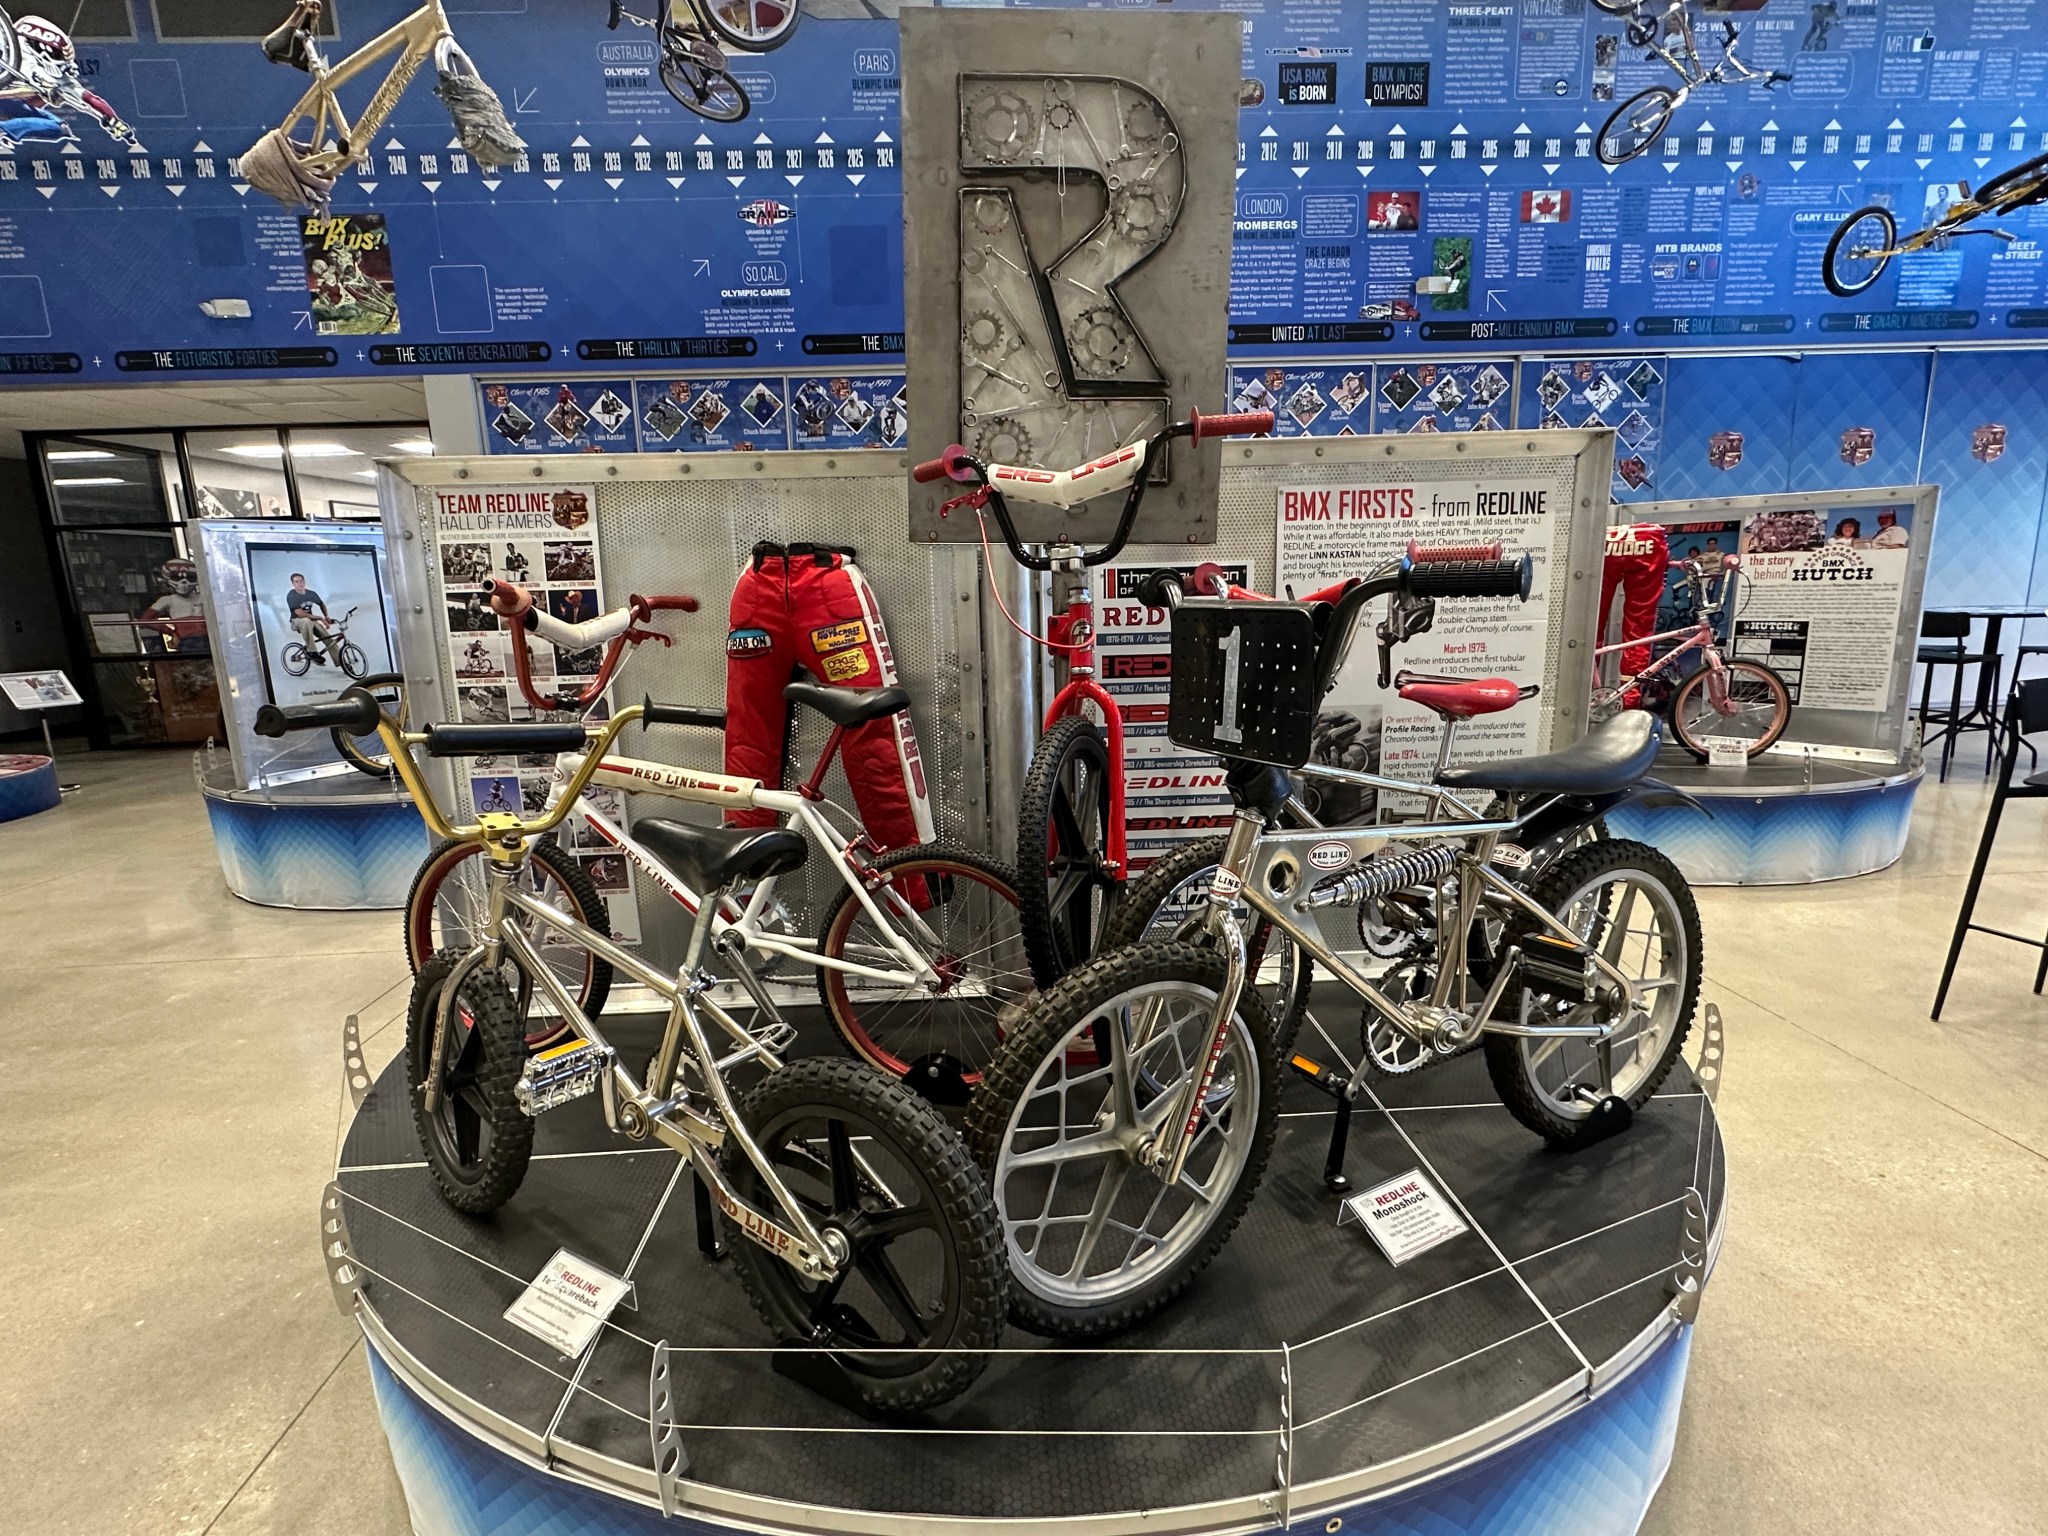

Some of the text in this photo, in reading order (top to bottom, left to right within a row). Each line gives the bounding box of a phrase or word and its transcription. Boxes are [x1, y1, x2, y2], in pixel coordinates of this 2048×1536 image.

[1449, 6, 1513, 15] THREE-PEAT!
[17, 23, 61, 43] RAD!
[1695, 23, 1707, 31] 25
[603, 46, 653, 60] AUSTRALIA
[859, 55, 889, 71] PARIS
[604, 67, 650, 76] OLYMPICS
[1283, 68, 1327, 83] USA BMX
[1372, 67, 1394, 82] BMX
[1409, 66, 1425, 82] THE
[1300, 85, 1327, 100] BORN
[1373, 84, 1423, 100] OLYMPICS!
[1245, 199, 1282, 214] LONDON
[737, 209, 797, 219] GRANDS
[1796, 213, 1821, 222] GARY
[304, 217, 350, 236] BMX
[1233, 221, 1298, 230] TROMBERGS
[323, 233, 382, 251] PLUS!
[1655, 243, 1723, 254] MTB BRANDS
[2008, 242, 2037, 250] MEET
[2005, 251, 2043, 260] STREET
[1305, 257, 1350, 269] CRAZE BEGINS
[721, 288, 790, 297] OLYMPIC GAMES
[1672, 318, 1690, 333] THE
[1855, 314, 1871, 329] THE
[1272, 325, 1347, 341] UNITED AT LAST
[1471, 321, 1575, 338] POST-MILLENNIUM BMX
[616, 341, 634, 357] THE
[686, 339, 729, 354] THIRTIES
[861, 335, 904, 351] THE BMX
[153, 350, 279, 368] THE FUTURISTIC FORTIES
[396, 344, 529, 363] THE SEVENTH GENERATION
[437, 493, 550, 514] TEAM REDLINE
[1285, 489, 1547, 521] BMX FIRSTS from REDLINE
[439, 513, 552, 531] HALL OF FAMERS
[1284, 523, 1325, 531] Innovation.
[1350, 521, 1390, 531] beginnings
[1393, 520, 1401, 528] of
[1474, 519, 1492, 527] (Mild
[1494, 518, 1512, 526] steel,
[1682, 522, 1725, 533] HUTCH
[1329, 531, 1368, 540] affordable,
[1436, 528, 1461, 536] HEAVY.
[1482, 527, 1503, 537] along
[1284, 540, 1388, 551] REDLINE, motorcycle frame
[1508, 545, 1546, 554] swingarms
[1605, 540, 1654, 556] JUDGE
[1309, 551, 1328, 559] LINN
[1330, 550, 1361, 559] KASTAN
[1299, 561, 1329, 570] brought
[1749, 556, 1795, 567] the story
[1822, 560, 1845, 568] BMX
[1283, 572, 1305, 580] plenty
[1754, 568, 1787, 580] behind
[1792, 568, 1874, 581] HUTCH
[1103, 607, 1165, 626] RED
[1438, 616, 1488, 624] double-clamp
[1750, 622, 1793, 630] HUTCH
[751, 636, 768, 649] ON
[1444, 642, 1488, 654] March 1979:
[828, 654, 860, 668] OAKLEY
[1404, 657, 1430, 665] Redline
[1432, 656, 1470, 664] introduces
[830, 664, 858, 676] GRIPS
[1440, 665, 1493, 674] 4130 Chromoly
[1213, 625, 1243, 744] 1
[1413, 714, 1432, 724] they?
[1385, 721, 1526, 733] Profile introduced their
[1384, 735, 1416, 744] Chromoly
[1456, 732, 1479, 740] around
[1384, 751, 1400, 760] Late
[1464, 748, 1484, 757] welds
[1402, 761, 1429, 770] chromo
[633, 767, 697, 789] RED LINE
[617, 843, 673, 893] RED LINE
[1218, 876, 1240, 888] LINE
[1375, 1181, 1420, 1207] REDLINE
[1372, 1190, 1430, 1221] Monoshock
[745, 1207, 790, 1251] LINE
[560, 1271, 601, 1297] REDLINE
